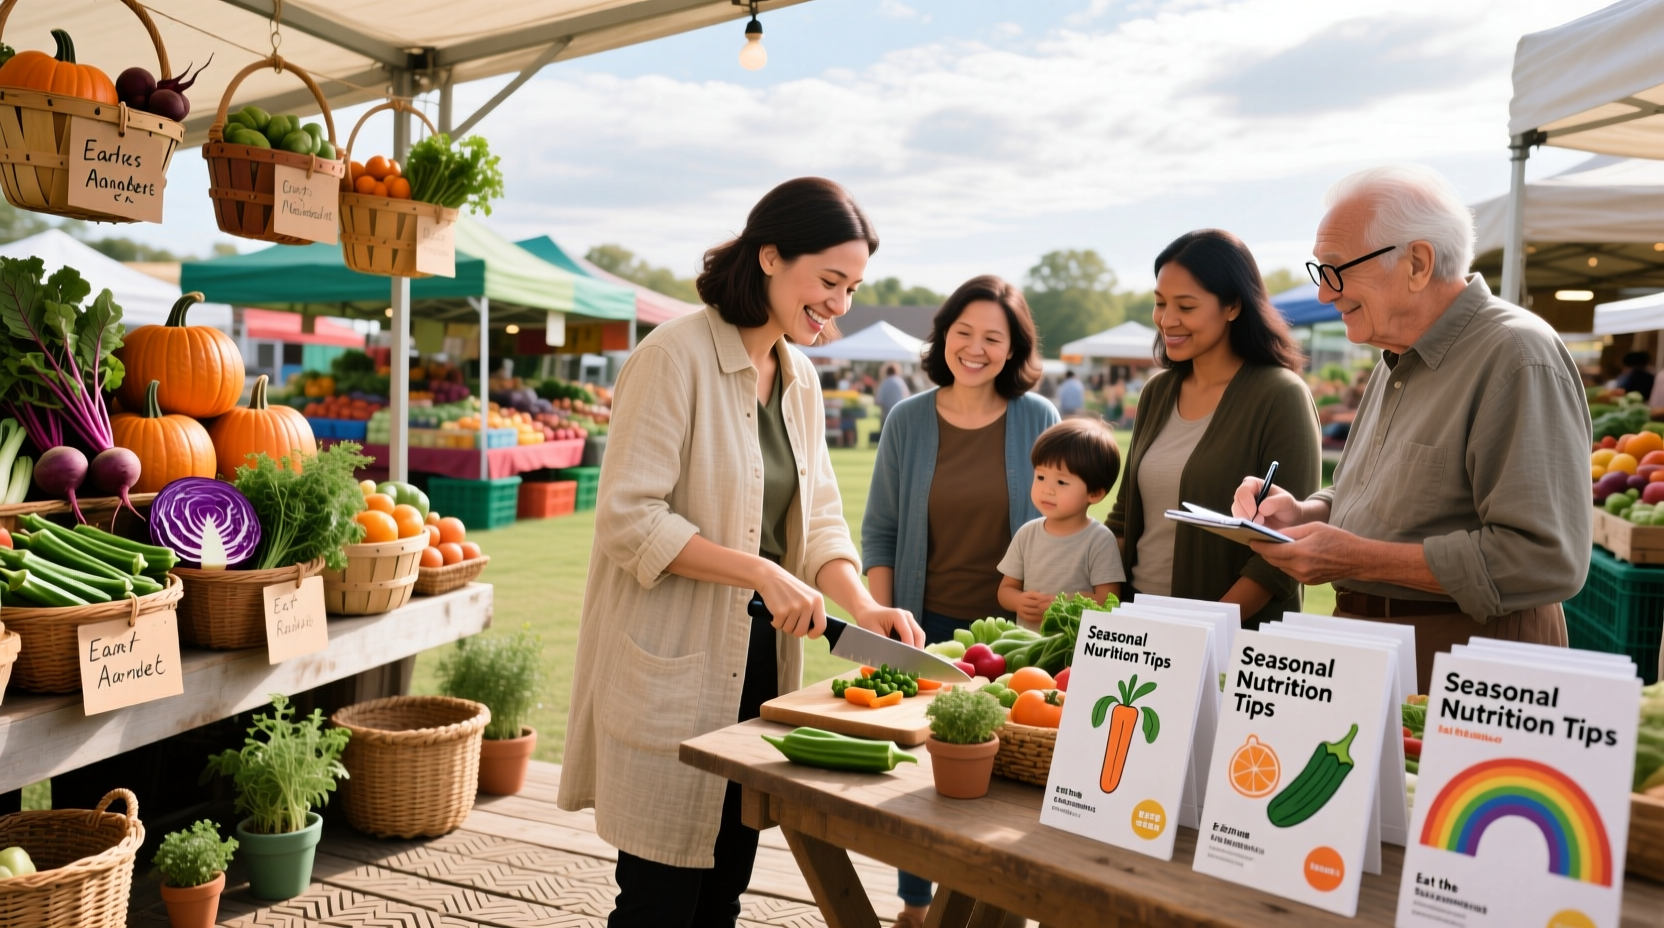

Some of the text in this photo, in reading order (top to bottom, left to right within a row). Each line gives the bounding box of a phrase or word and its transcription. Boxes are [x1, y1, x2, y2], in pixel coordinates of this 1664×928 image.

[1087, 625, 1148, 647] Seasonal
[1142, 650, 1171, 672] Tips
[1240, 646, 1335, 678] Seasonal
[1236, 669, 1332, 703] Nutrition
[1444, 672, 1559, 708] Seasonal
[1234, 692, 1275, 720] Tips
[1440, 697, 1555, 736] Nutrition
[1563, 716, 1618, 749] Tips
[1416, 872, 1459, 893] Eat the
